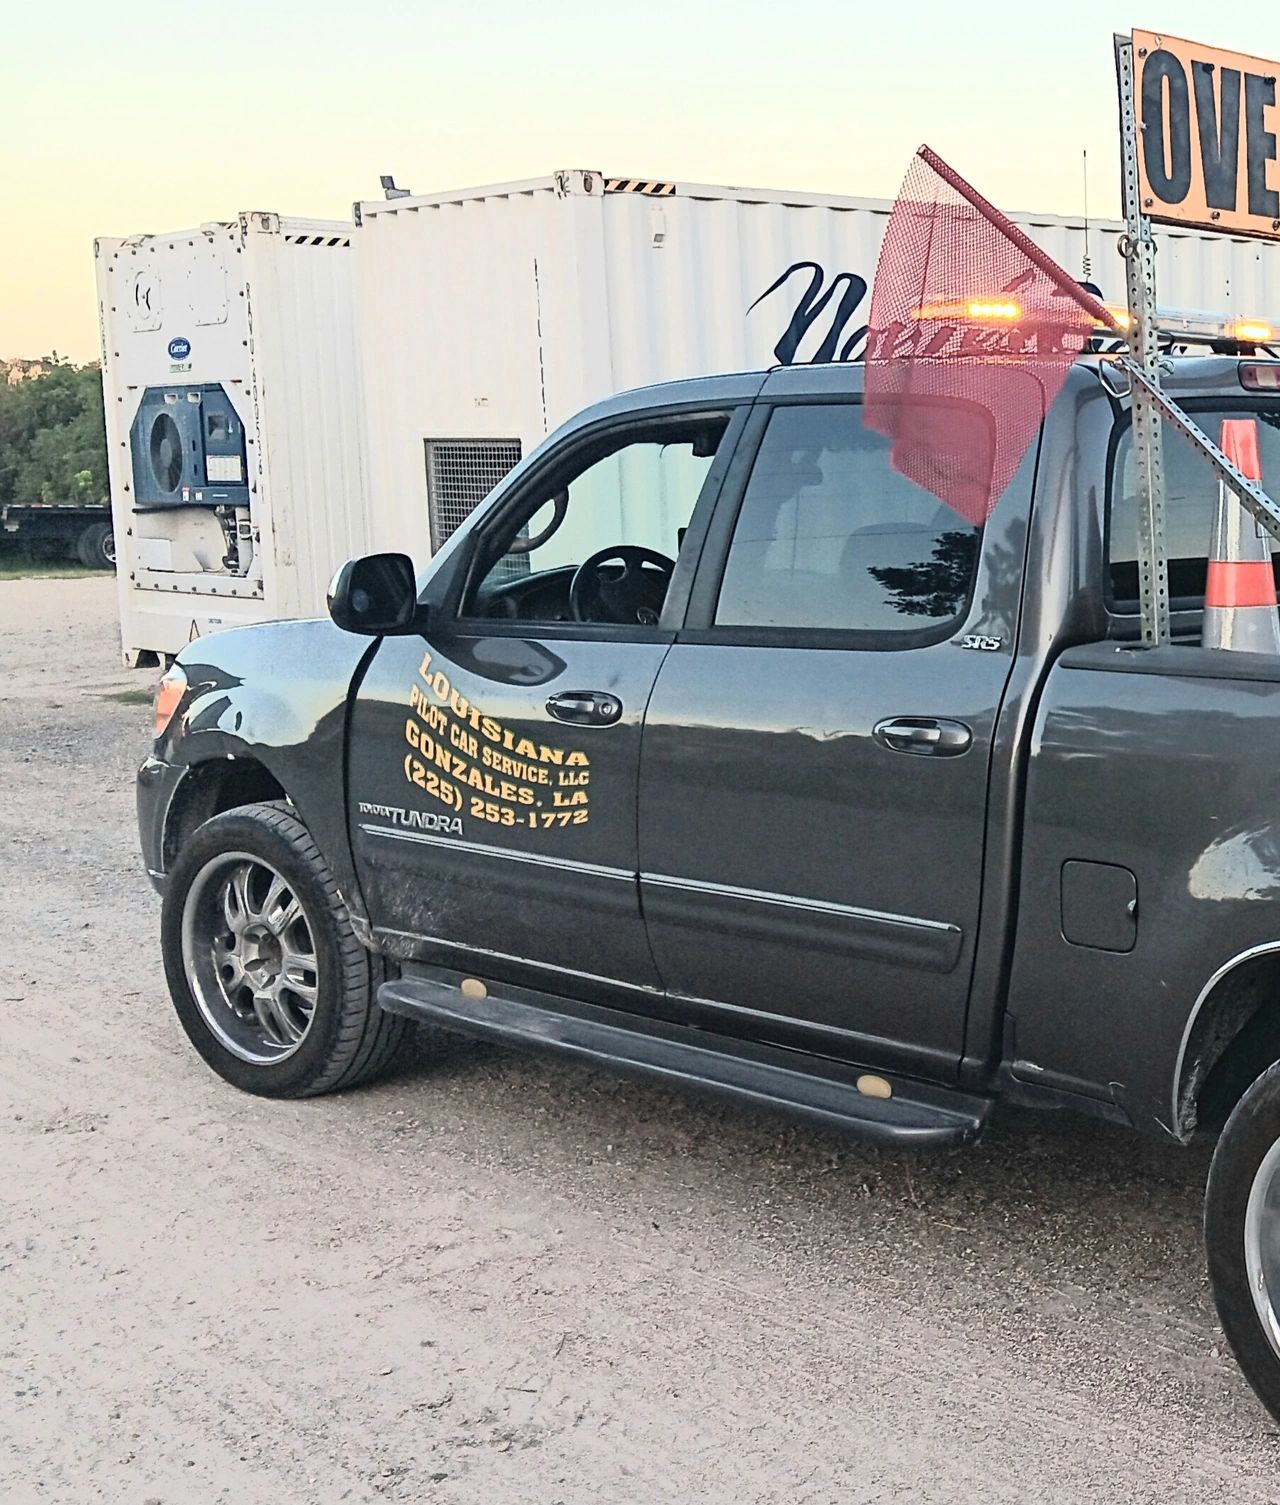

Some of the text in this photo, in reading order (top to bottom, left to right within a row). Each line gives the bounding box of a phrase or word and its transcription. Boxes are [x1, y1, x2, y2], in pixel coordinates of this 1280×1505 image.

[408, 684, 590, 787] PILOT CAR SERVICE, LLC
[418, 652, 590, 767] LOUISIANA
[388, 806, 463, 836] TUNDRA
[403, 752, 590, 829] (225) 253-1772
[553, 790, 590, 807] LA
